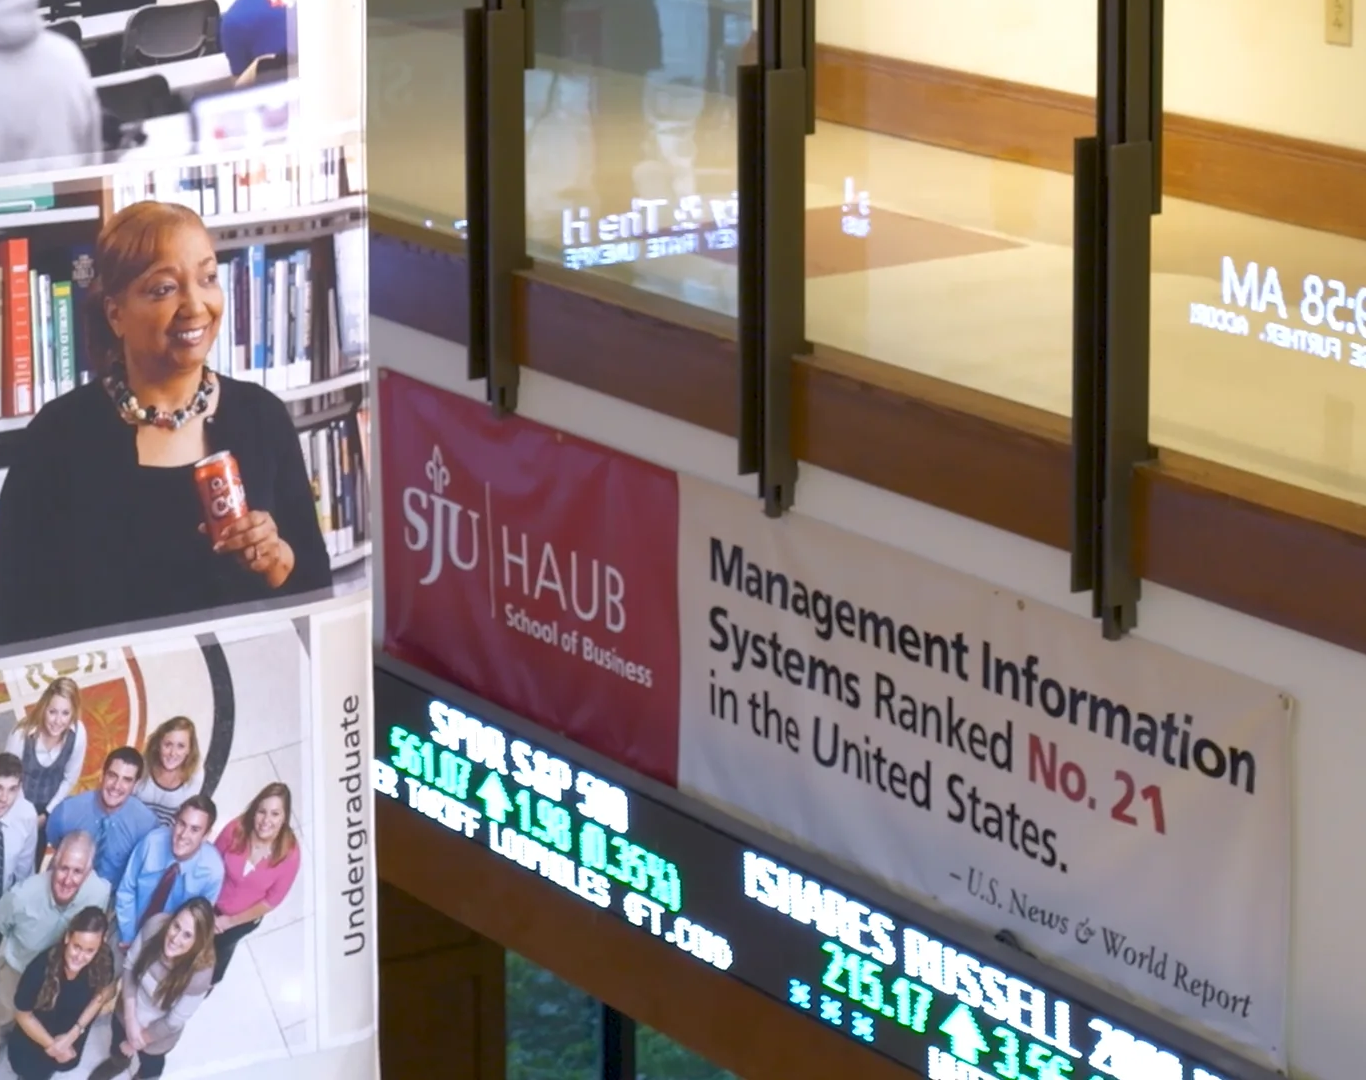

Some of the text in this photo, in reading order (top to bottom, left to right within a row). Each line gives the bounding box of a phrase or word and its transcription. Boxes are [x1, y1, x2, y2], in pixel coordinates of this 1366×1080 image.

[403, 486, 479, 586] SJU
[502, 525, 626, 633] HAUB
[505, 602, 653, 689] School of Business
[710, 536, 1257, 795] Management Information
[710, 607, 1168, 835] Systems Ranked No. 21
[710, 670, 1068, 874] in the United States.
[341, 694, 368, 956] Undergraduate
[821, 941, 933, 1033] 215.17
[903, 928, 1083, 1058] RUSSELL
[967, 865, 1003, 912] U.S.
[1009, 890, 1069, 936] News
[1074, 917, 1096, 945] &
[1101, 925, 1168, 983] World
[1174, 962, 1254, 1019] Report
